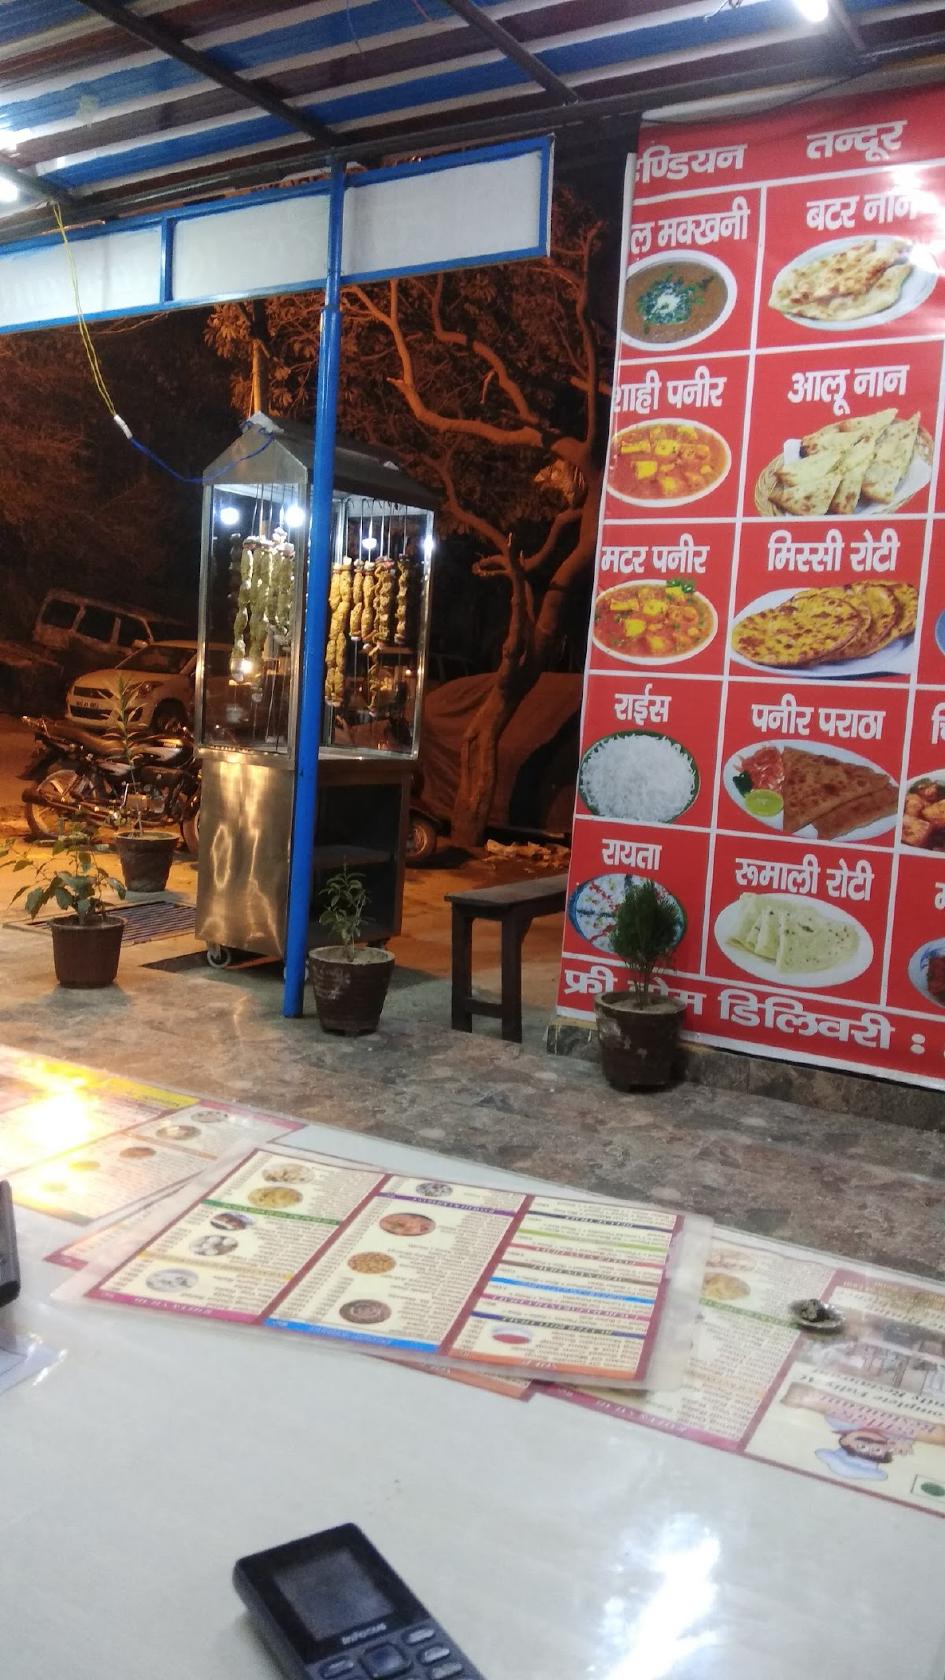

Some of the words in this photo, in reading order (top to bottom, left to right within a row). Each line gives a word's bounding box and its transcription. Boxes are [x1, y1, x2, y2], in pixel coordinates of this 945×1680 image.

[806, 120, 908, 162] तन्दूर
[630, 221, 656, 255] ल
[657, 195, 751, 247] मक्खनी
[806, 195, 860, 231] बटर
[863, 191, 924, 223] नान
[667, 365, 728, 409] पनीर
[787, 369, 850, 416] आलू
[854, 365, 910, 397] नान
[601, 546, 649, 574] मटर
[652, 532, 711, 574] पनीर
[767, 528, 845, 573] मिस्सी
[850, 528, 900, 573] रोटी
[614, 683, 672, 724] राईस
[751, 693, 813, 736] पनीर
[818, 707, 886, 740] पराठा
[602, 838, 663, 871] रायता
[735, 853, 821, 896] रूमाली
[826, 858, 875, 901] रोटी
[564, 965, 618, 994] फ्री
[717, 988, 896, 1050] डिलिवरी
